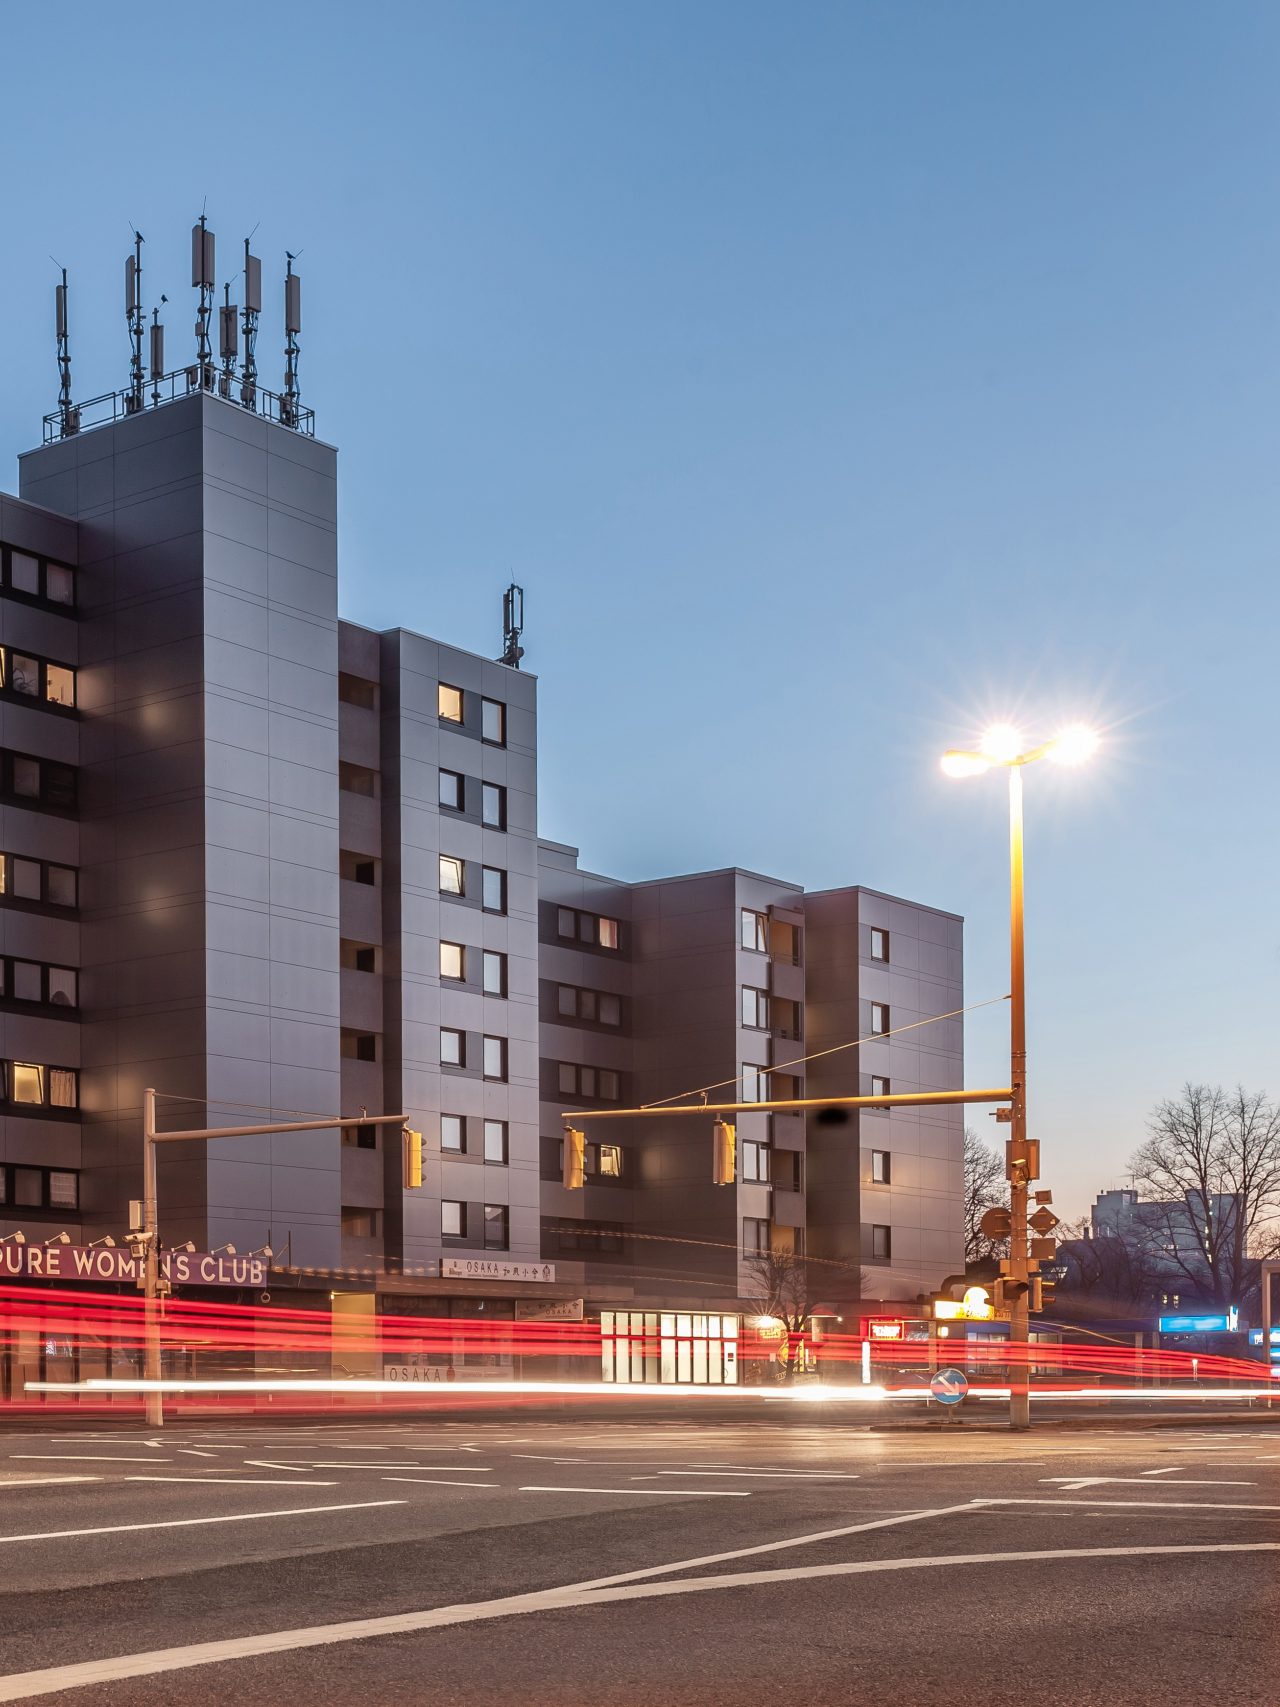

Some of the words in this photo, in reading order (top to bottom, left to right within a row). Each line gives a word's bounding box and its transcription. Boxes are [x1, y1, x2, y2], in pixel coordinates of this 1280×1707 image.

[200, 1257, 263, 1284] CLUB
[466, 1261, 499, 1274] OSAKA
[389, 1367, 441, 1382] OSAKA
